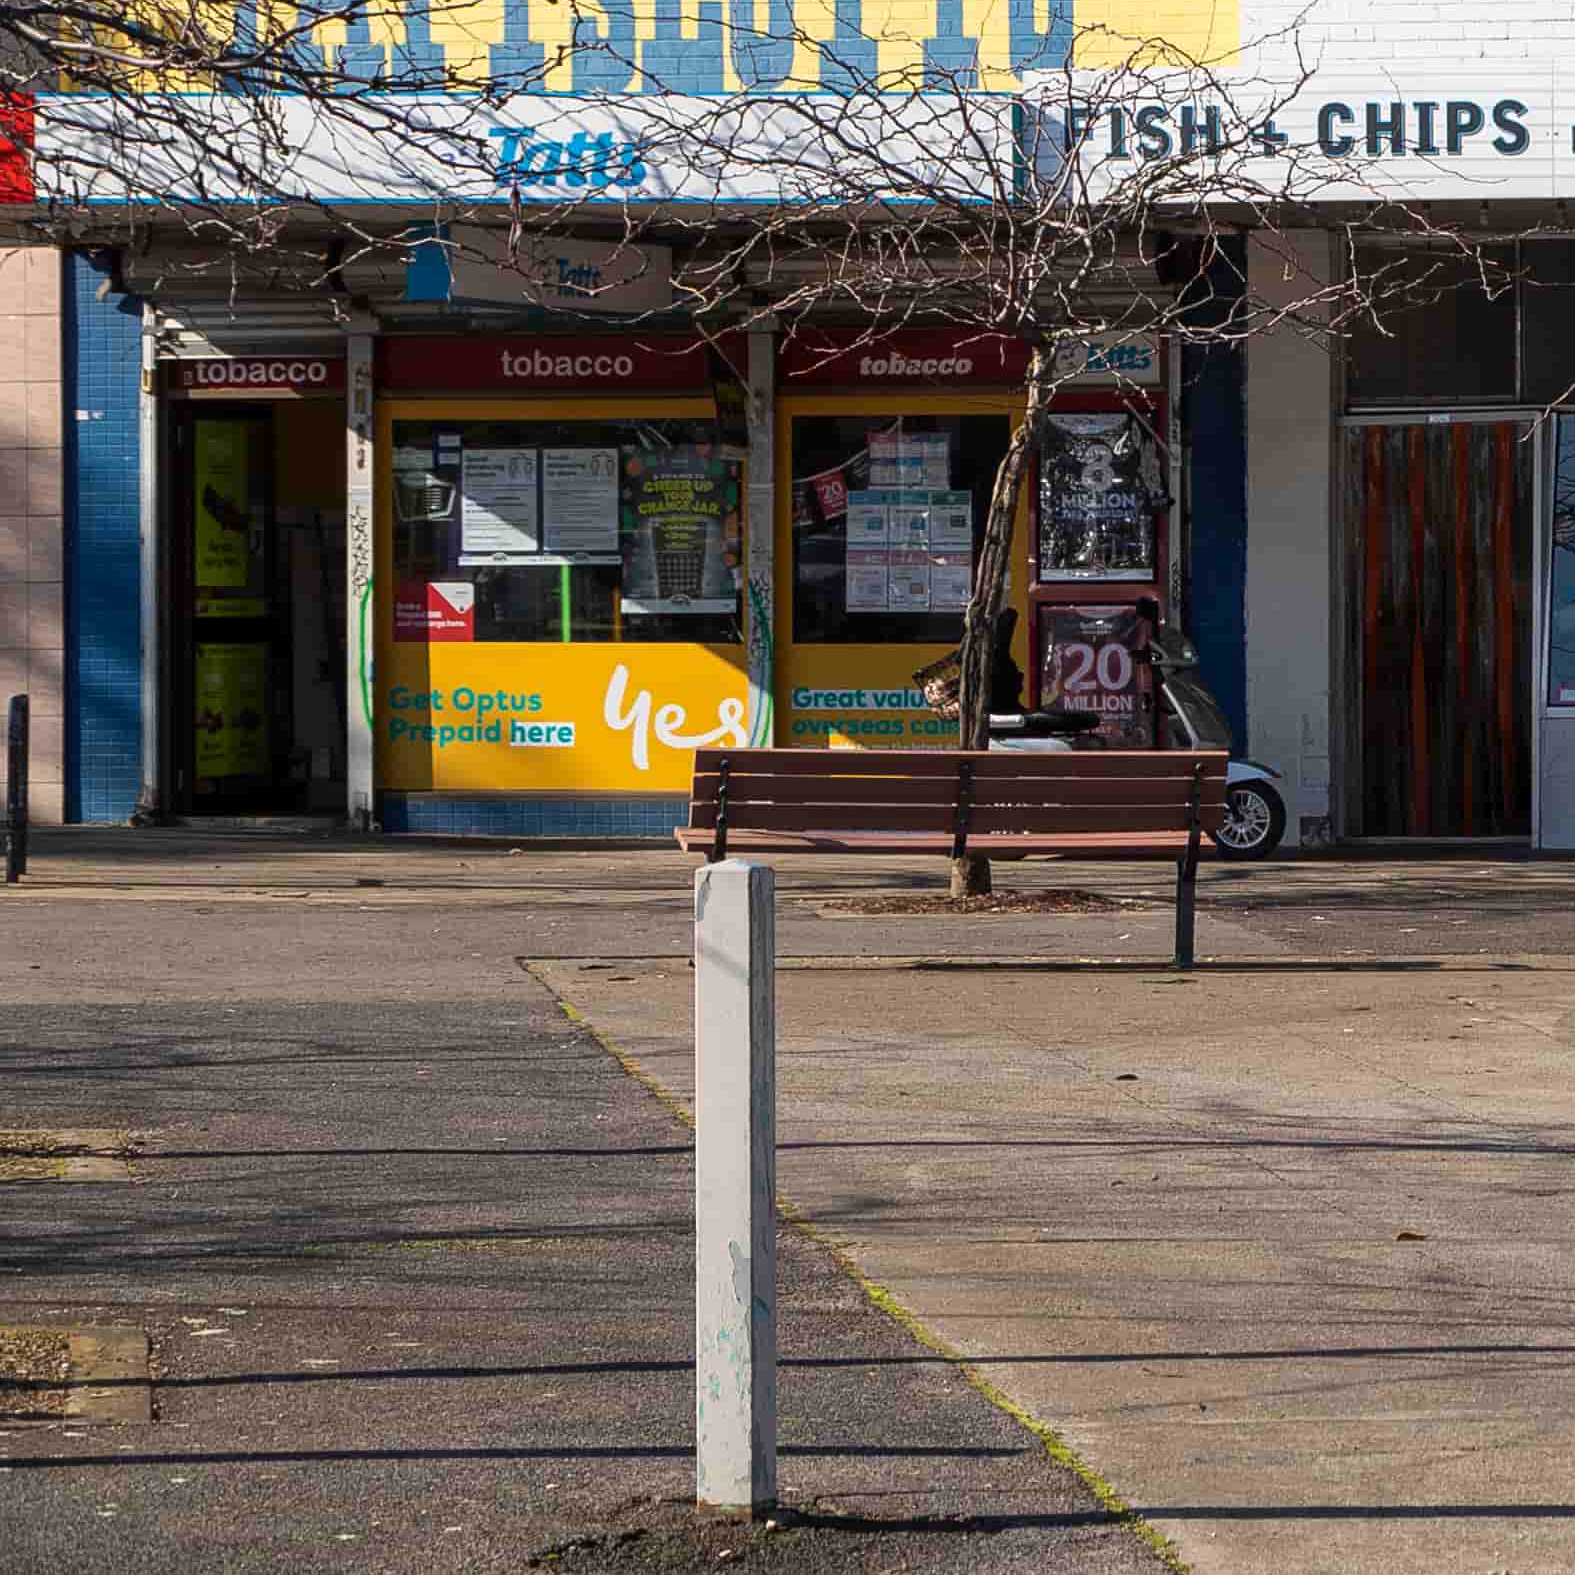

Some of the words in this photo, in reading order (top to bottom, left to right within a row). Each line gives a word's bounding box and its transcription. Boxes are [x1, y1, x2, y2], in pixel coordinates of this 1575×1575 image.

[1063, 103, 1222, 161] FISH
[1317, 99, 1532, 158] CHIPS
[489, 127, 646, 187] Tatts
[196, 359, 327, 385] tobacco
[502, 350, 634, 377] tobacco
[860, 351, 974, 377] tobacco
[388, 686, 444, 712] Get
[452, 686, 543, 718] Optus
[793, 687, 867, 709] Great
[872, 687, 929, 709] valu
[1063, 695, 1134, 711] MILLION
[389, 718, 503, 748] Prepaid
[510, 719, 574, 744] here
[792, 719, 904, 735] overseas
